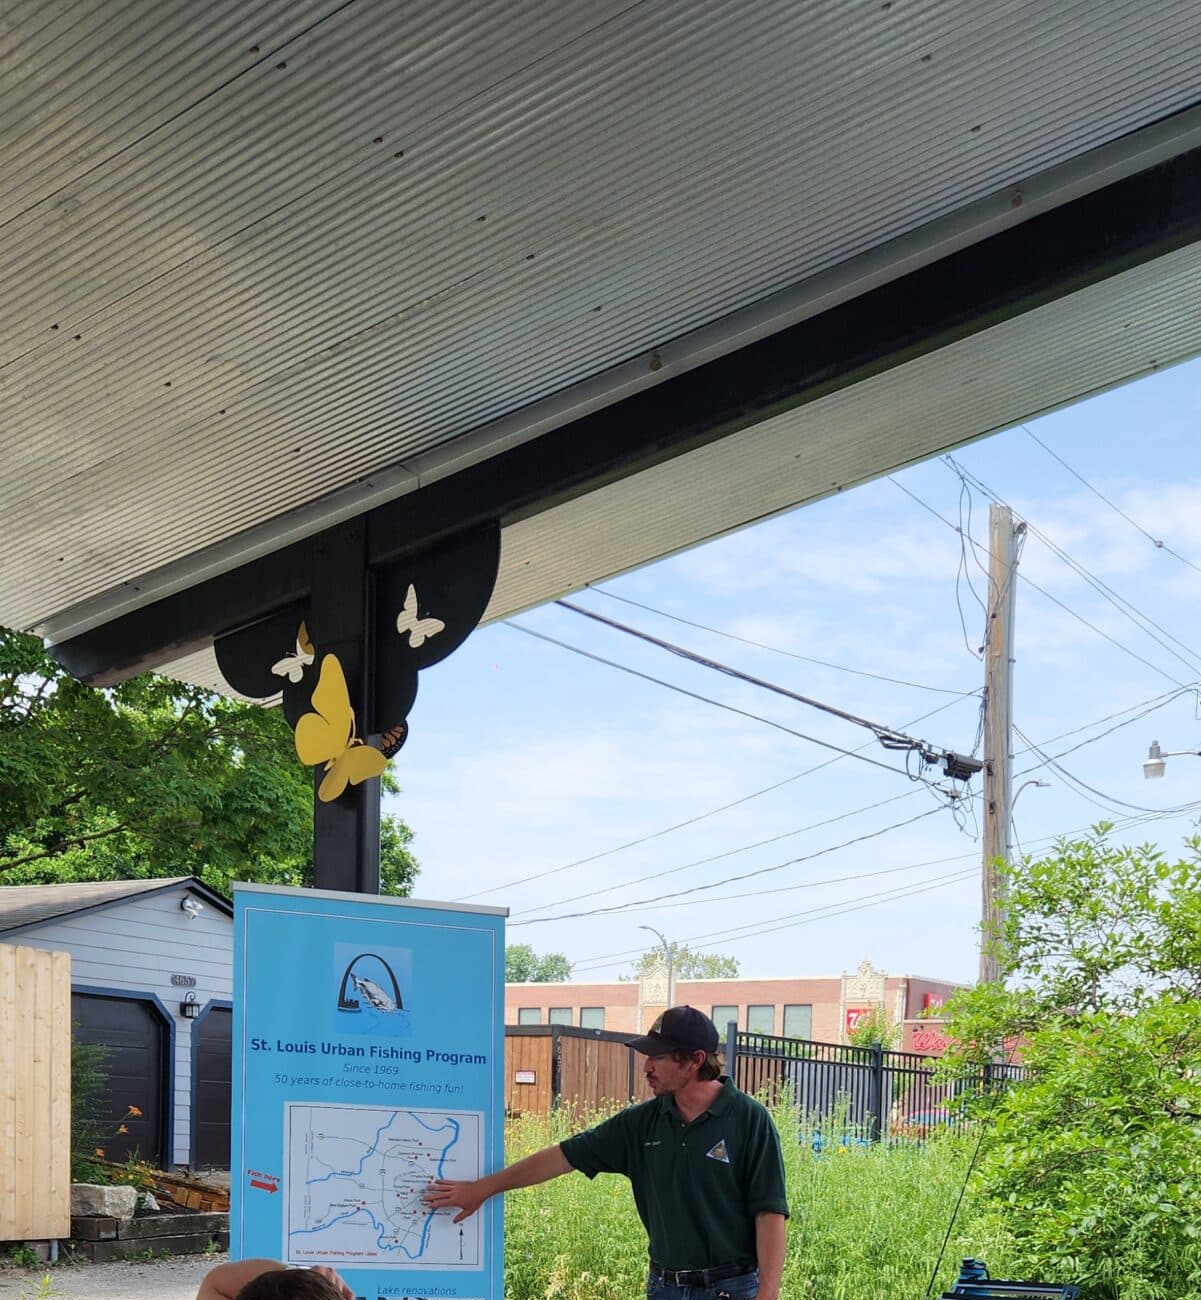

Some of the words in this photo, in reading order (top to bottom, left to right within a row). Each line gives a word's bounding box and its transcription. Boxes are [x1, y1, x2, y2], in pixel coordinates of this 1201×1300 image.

[251, 1038, 271, 1052] St.
[277, 1040, 316, 1054] Louis
[321, 1042, 365, 1057] Urban
[370, 1046, 421, 1063] Fishing
[426, 1049, 487, 1066] Program
[343, 1063, 371, 1074] Since
[374, 1064, 399, 1075] 1969
[274, 1074, 288, 1084] 50
[291, 1077, 320, 1087] years
[322, 1076, 334, 1087] of
[335, 1077, 407, 1091] close-to-home
[409, 1081, 442, 1094] fishing
[444, 1083, 464, 1094] fun!
[247, 1168, 263, 1179] Fish
[264, 1173, 281, 1183] here
[377, 1285, 400, 1295] Lake
[402, 1286, 457, 1296] renovations
